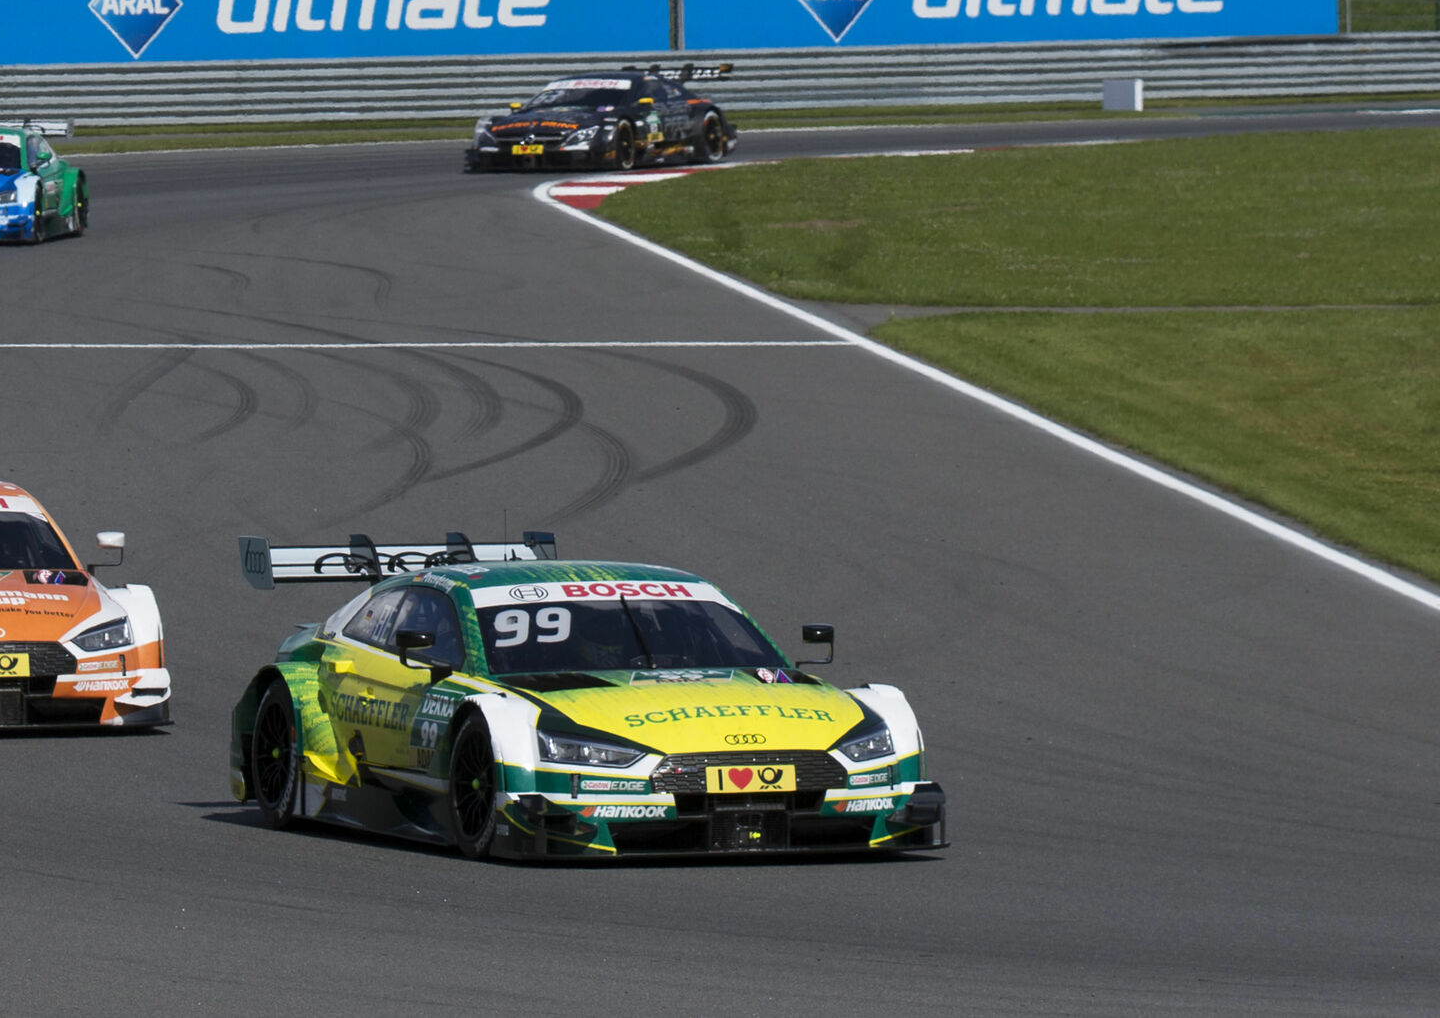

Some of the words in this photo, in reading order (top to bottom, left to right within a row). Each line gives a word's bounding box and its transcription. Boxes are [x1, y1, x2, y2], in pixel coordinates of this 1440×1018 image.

[561, 582, 693, 599] BOSCH
[493, 606, 572, 647] 99
[329, 691, 410, 732] SCHAEFFLER
[421, 693, 455, 718] DEKRA
[624, 705, 836, 729] SCHAEFFLER
[421, 721, 438, 748] 99
[611, 781, 647, 791] EDGE
